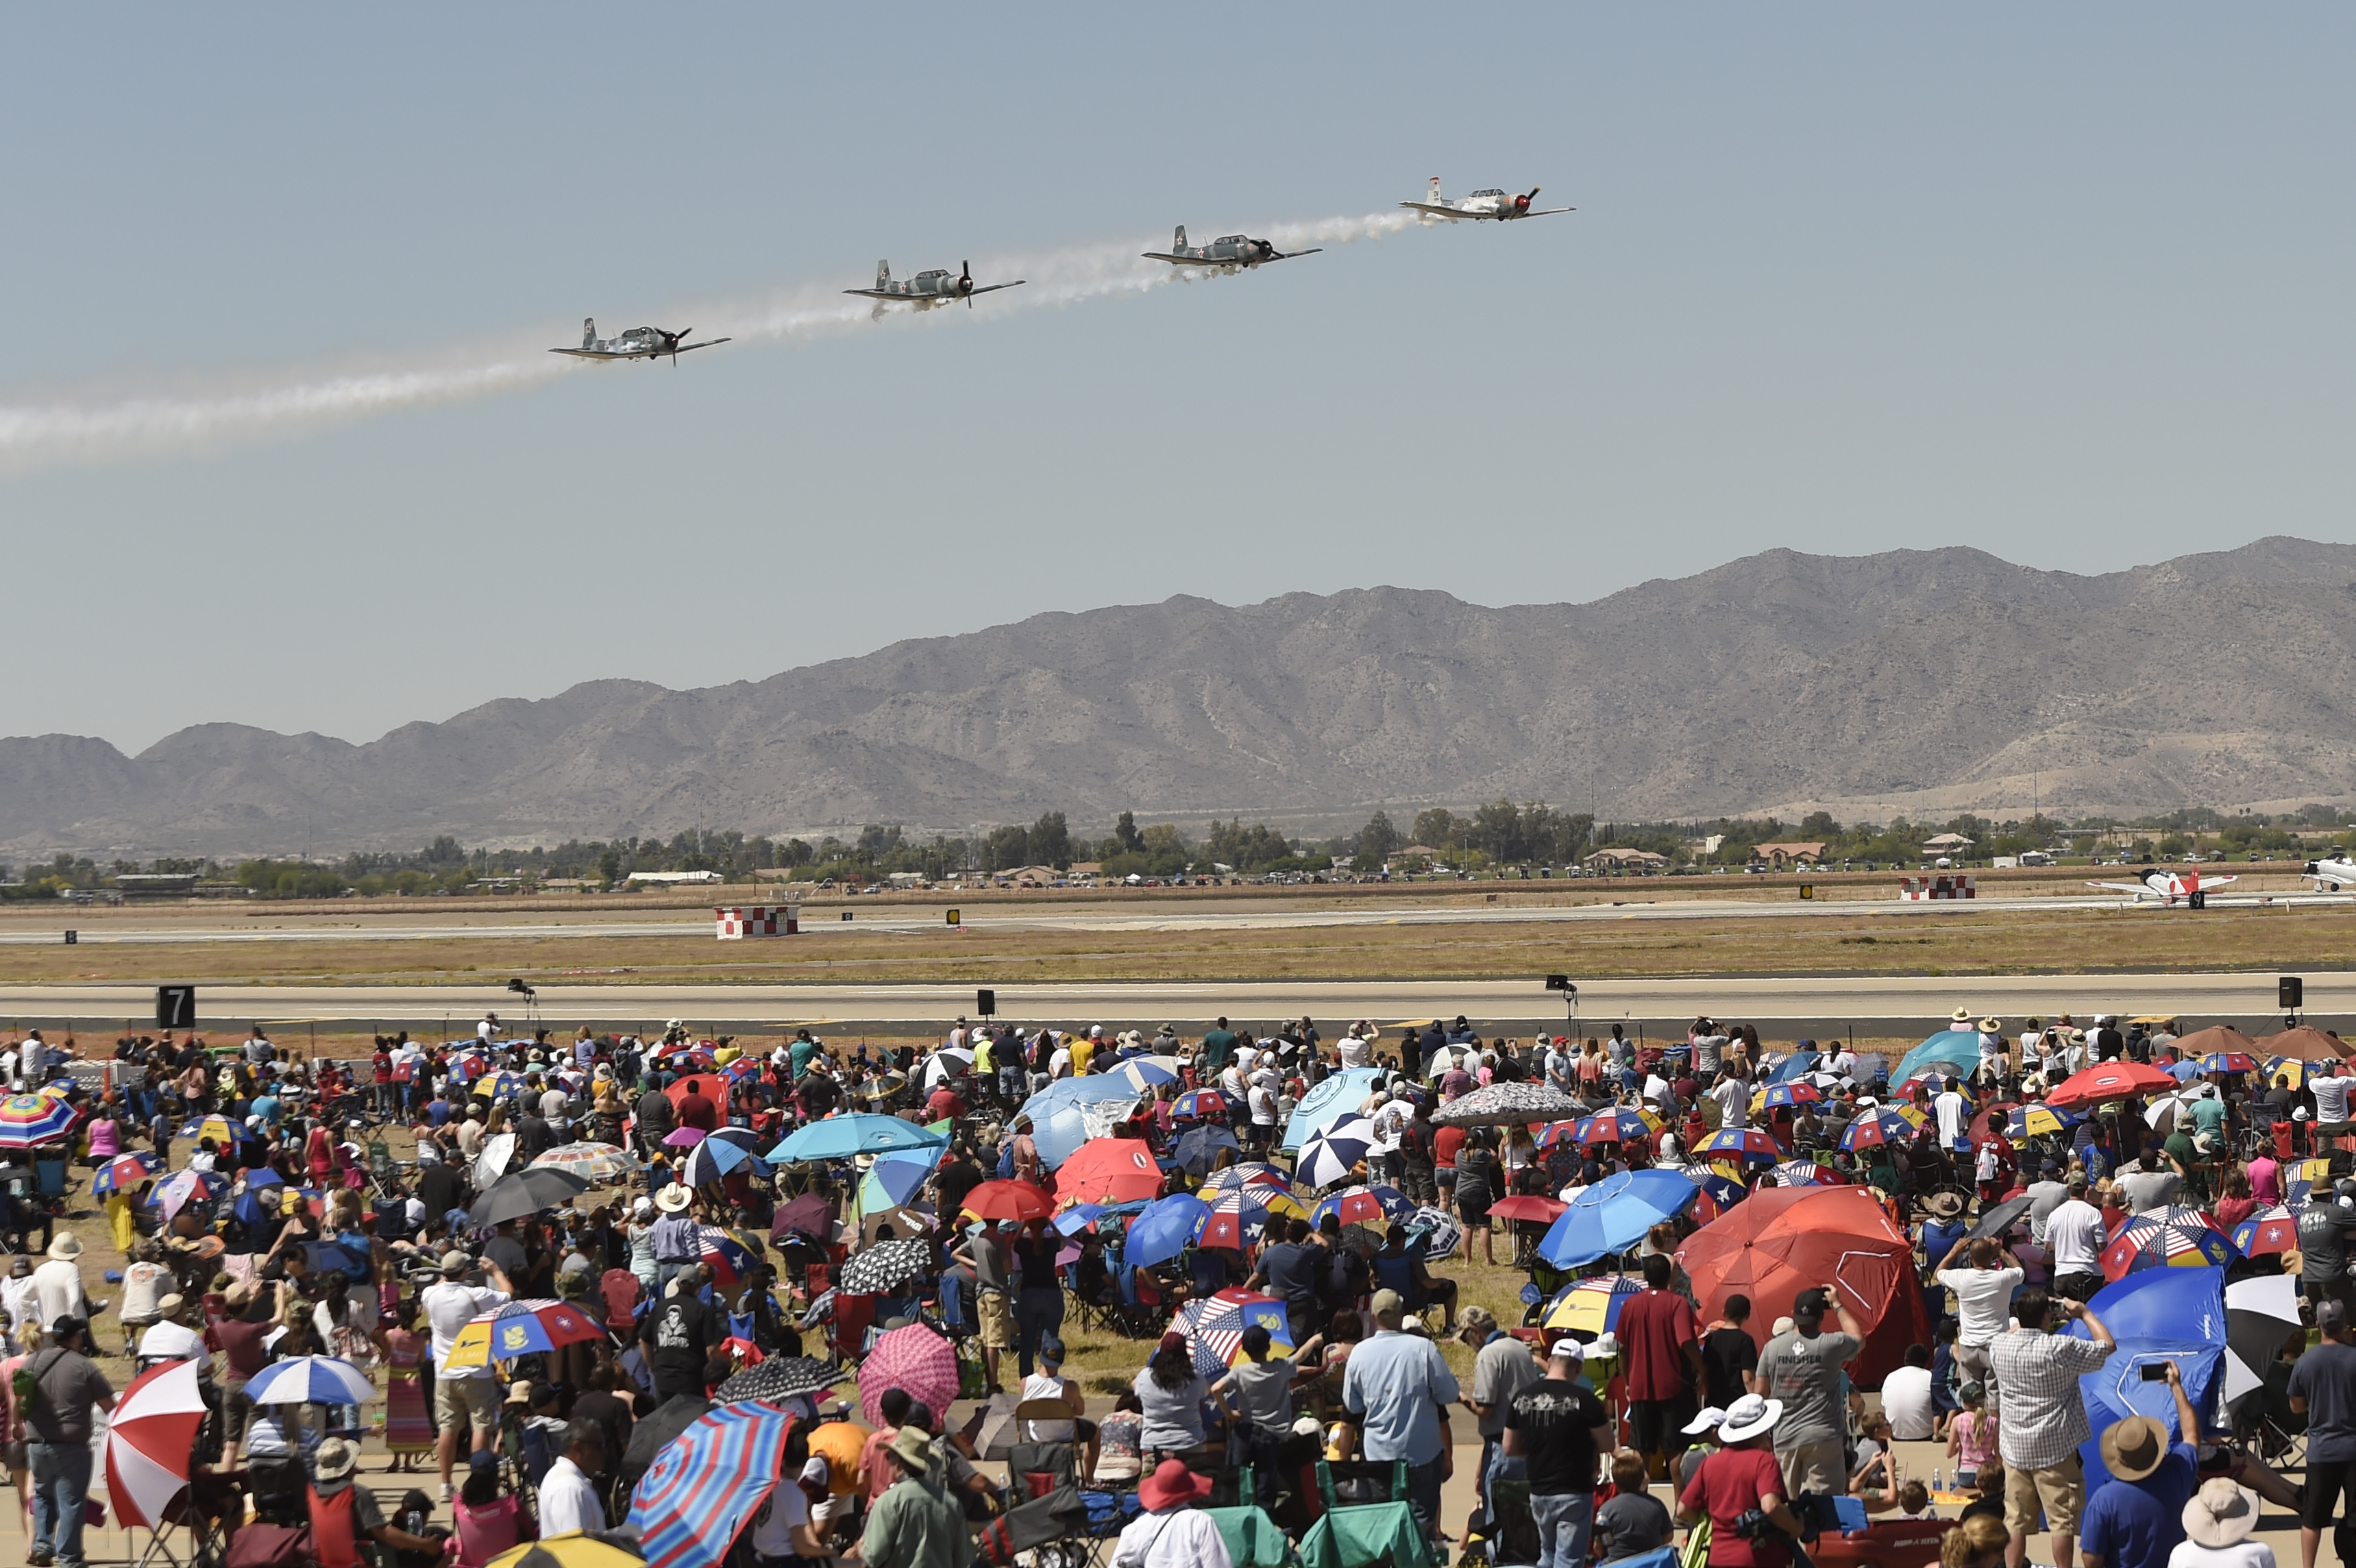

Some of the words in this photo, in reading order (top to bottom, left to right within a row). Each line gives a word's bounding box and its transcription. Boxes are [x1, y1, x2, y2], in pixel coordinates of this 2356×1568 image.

[2194, 892, 2201, 907] 9
[168, 989, 186, 1025] 7
[898, 1210, 923, 1232] Wilson
[1778, 1355, 1821, 1364] FINISHER
